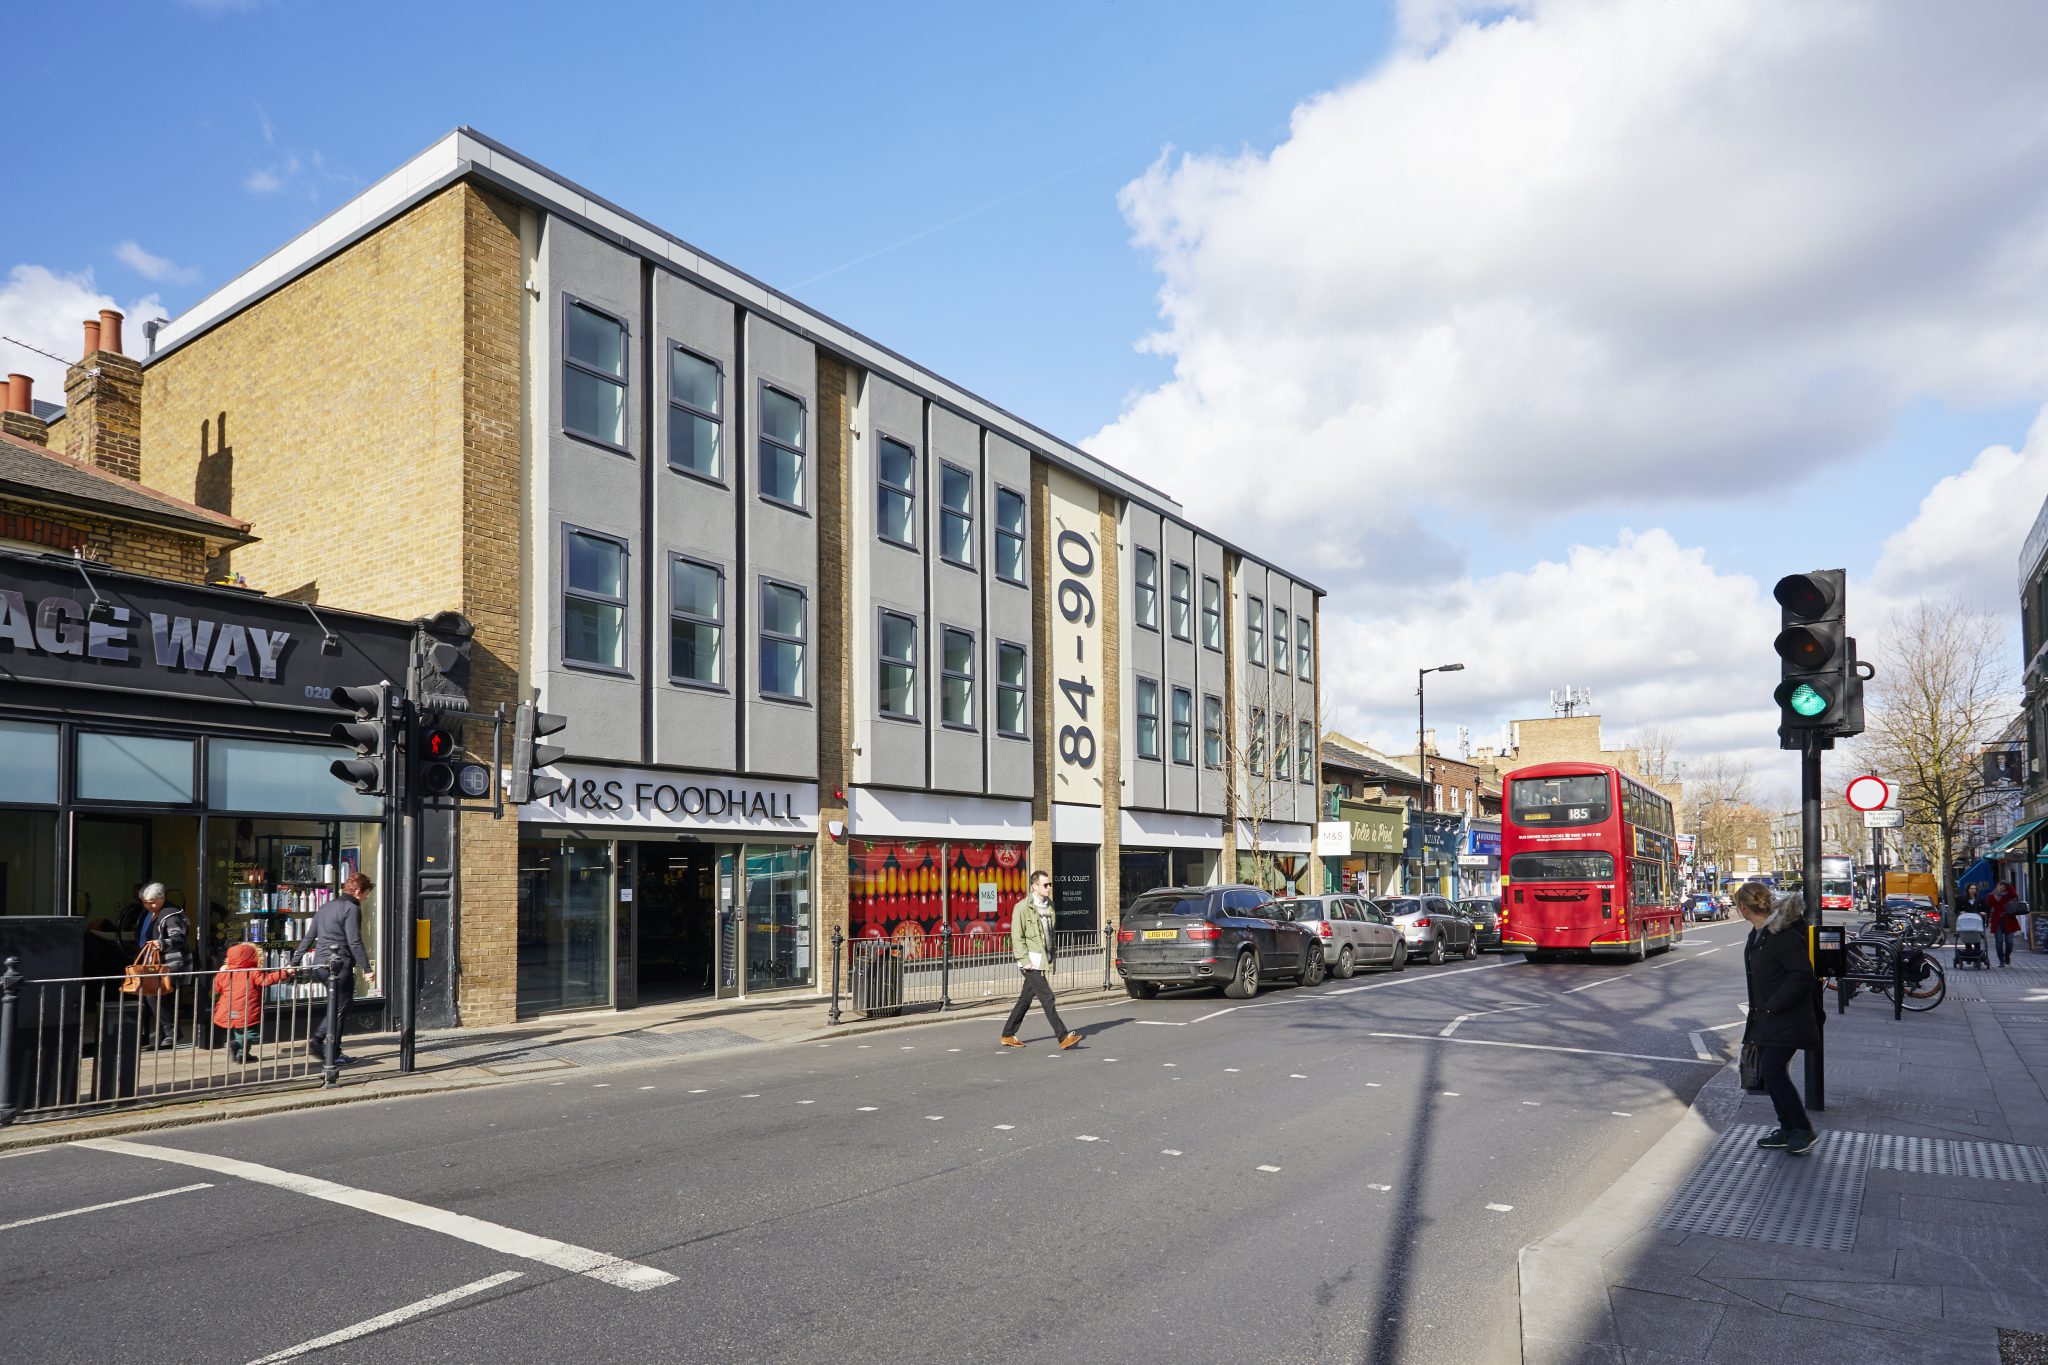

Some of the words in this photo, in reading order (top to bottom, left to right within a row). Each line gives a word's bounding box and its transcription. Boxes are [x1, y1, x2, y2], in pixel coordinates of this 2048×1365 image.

[150, 612, 291, 680] WAY
[304, 685, 332, 700] 020
[549, 778, 623, 811] M&S
[635, 783, 801, 820] FOODHALL
[1570, 808, 1589, 820] 185
[1323, 832, 1343, 841] M&S
[1351, 821, 1371, 842] Jolie
[228, 860, 258, 870] Beauty
[981, 890, 995, 900] M&S
